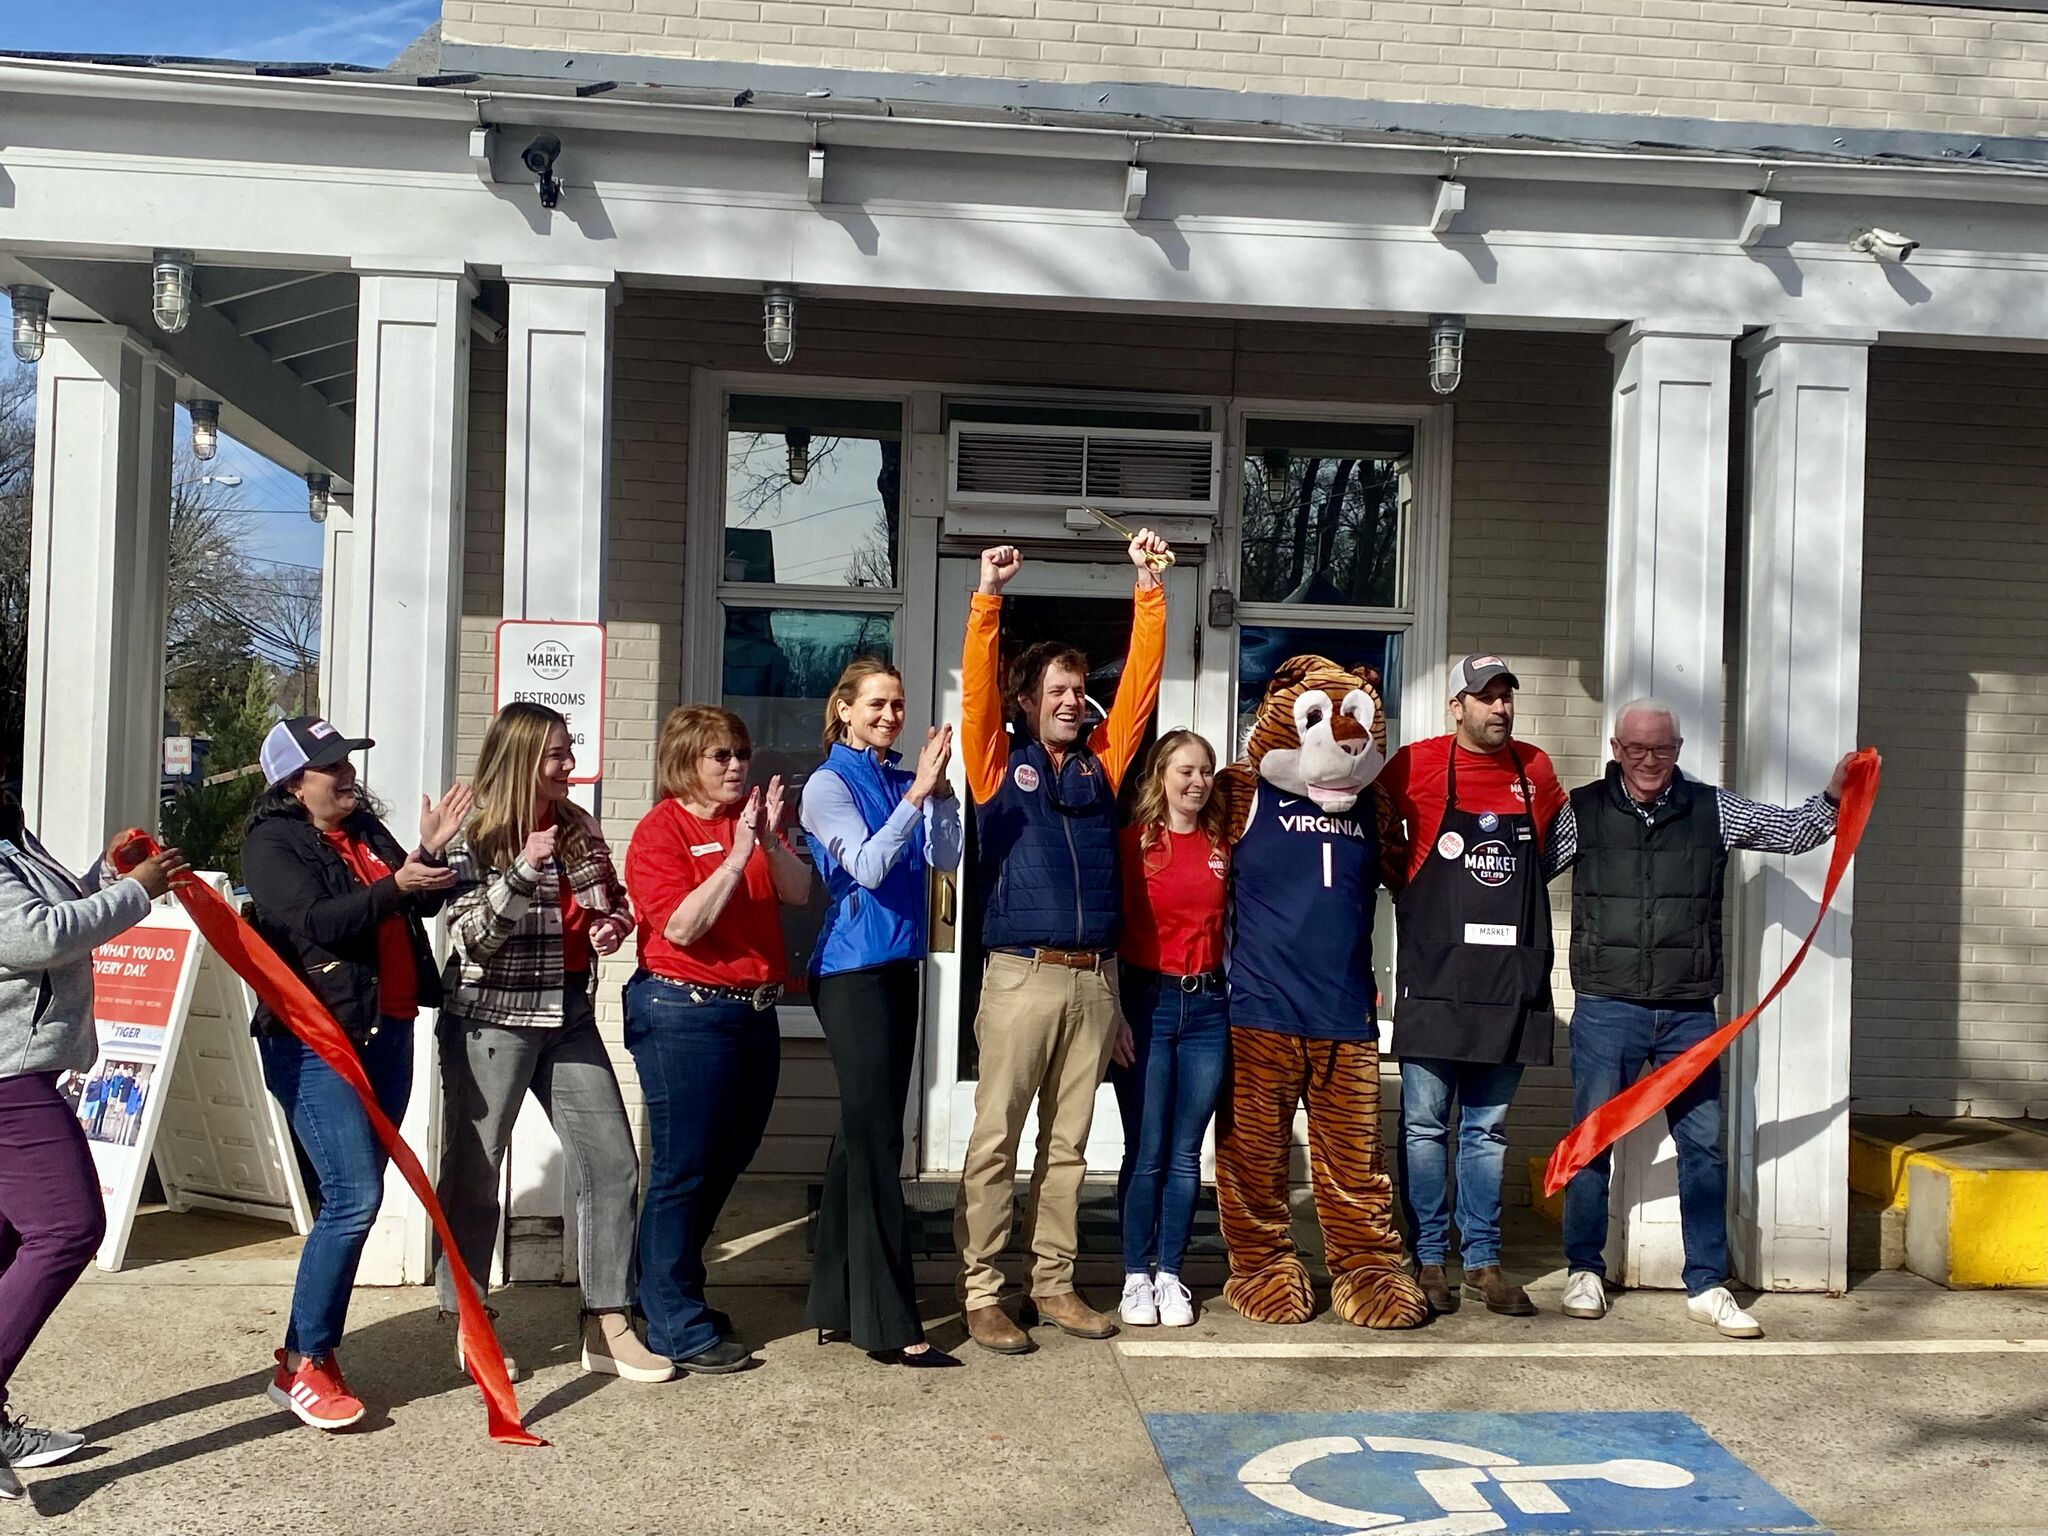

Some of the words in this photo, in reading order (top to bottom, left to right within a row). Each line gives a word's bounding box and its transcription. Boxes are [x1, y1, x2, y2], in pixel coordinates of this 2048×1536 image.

[527, 653, 575, 667] MARKET
[514, 691, 586, 706] RESTROOMS
[173, 744, 183, 752] NO
[1510, 783, 1536, 794] MAET
[1278, 815, 1365, 839] VIRGINIA
[1486, 846, 1499, 855] THE
[1322, 842, 1332, 888] 1
[1464, 853, 1517, 872] MARKET
[1479, 927, 1510, 937] MARKET
[99, 943, 131, 958] WHAT
[132, 945, 156, 961] YOU
[155, 947, 176, 962] DO.
[123, 964, 148, 977] DAY.
[114, 1026, 141, 1039] TIGER
